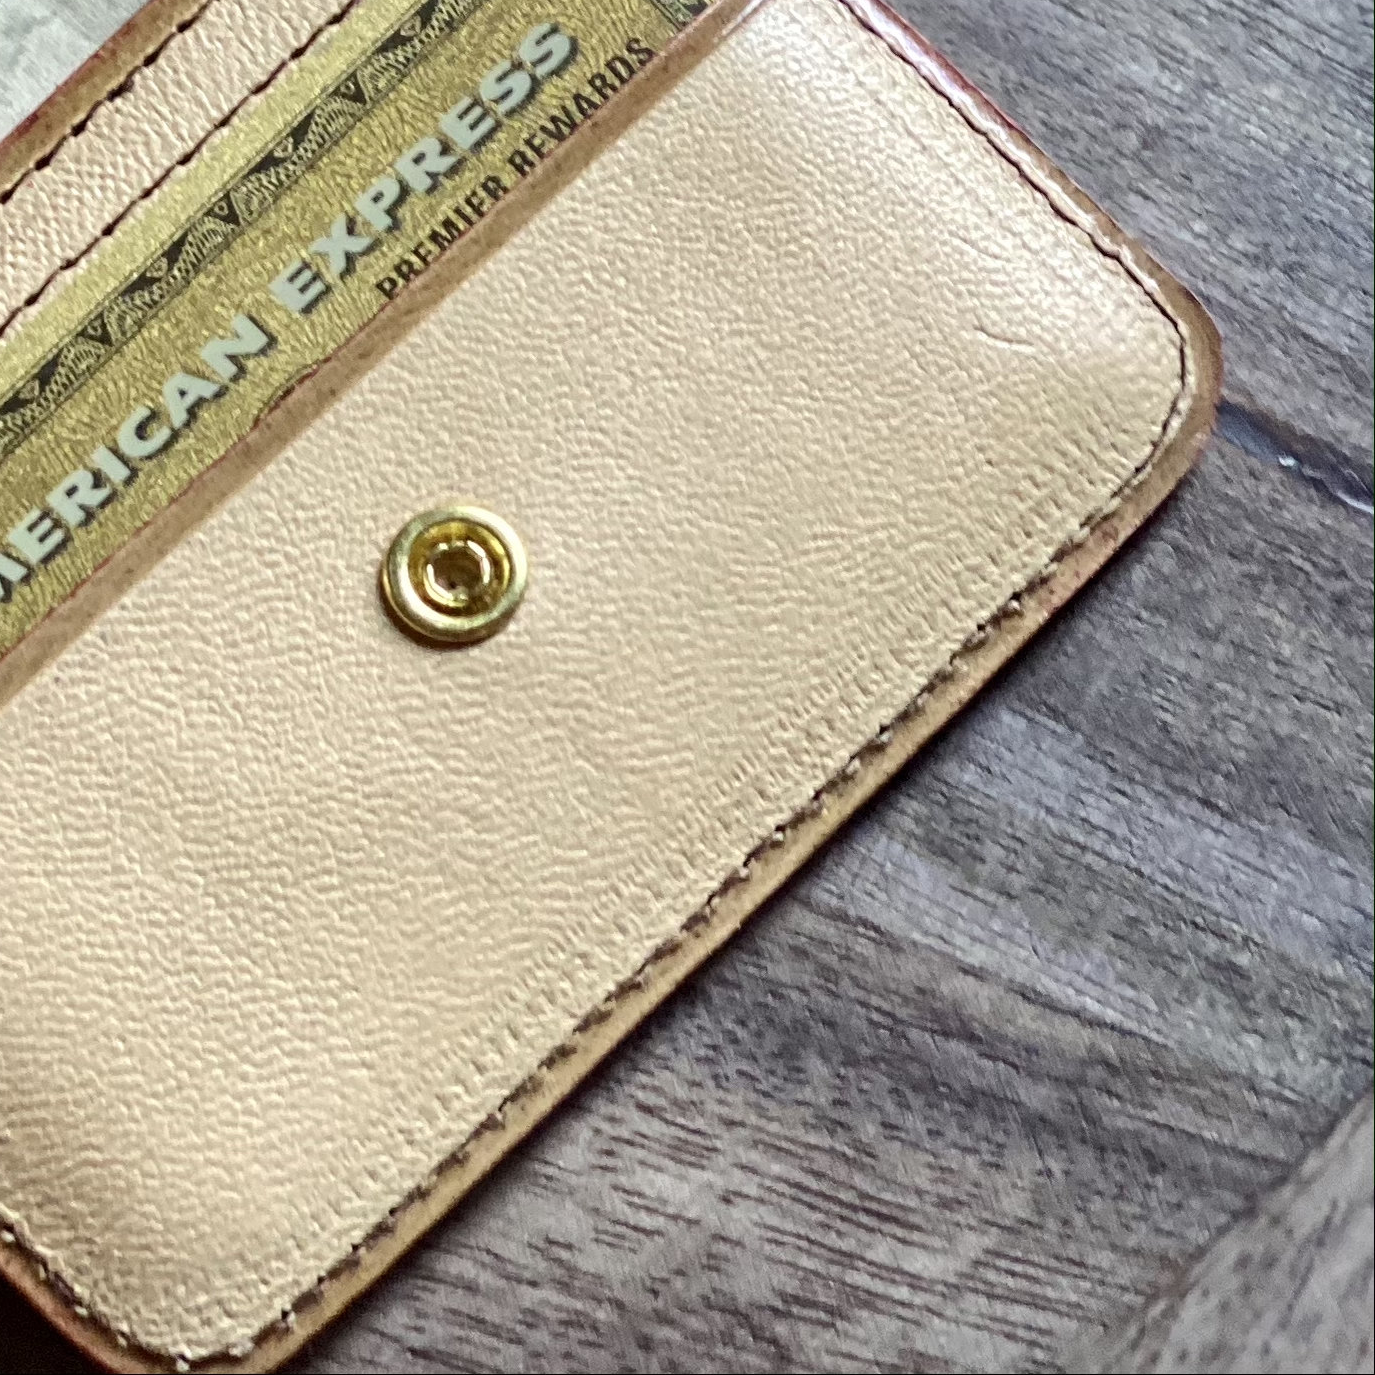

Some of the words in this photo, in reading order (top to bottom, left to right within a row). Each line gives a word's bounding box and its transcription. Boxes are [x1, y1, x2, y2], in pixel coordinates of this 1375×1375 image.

[268, 22, 579, 315] EXPRESS
[376, 174, 510, 301] PREMIER
[507, 37, 657, 178] REWARDS
